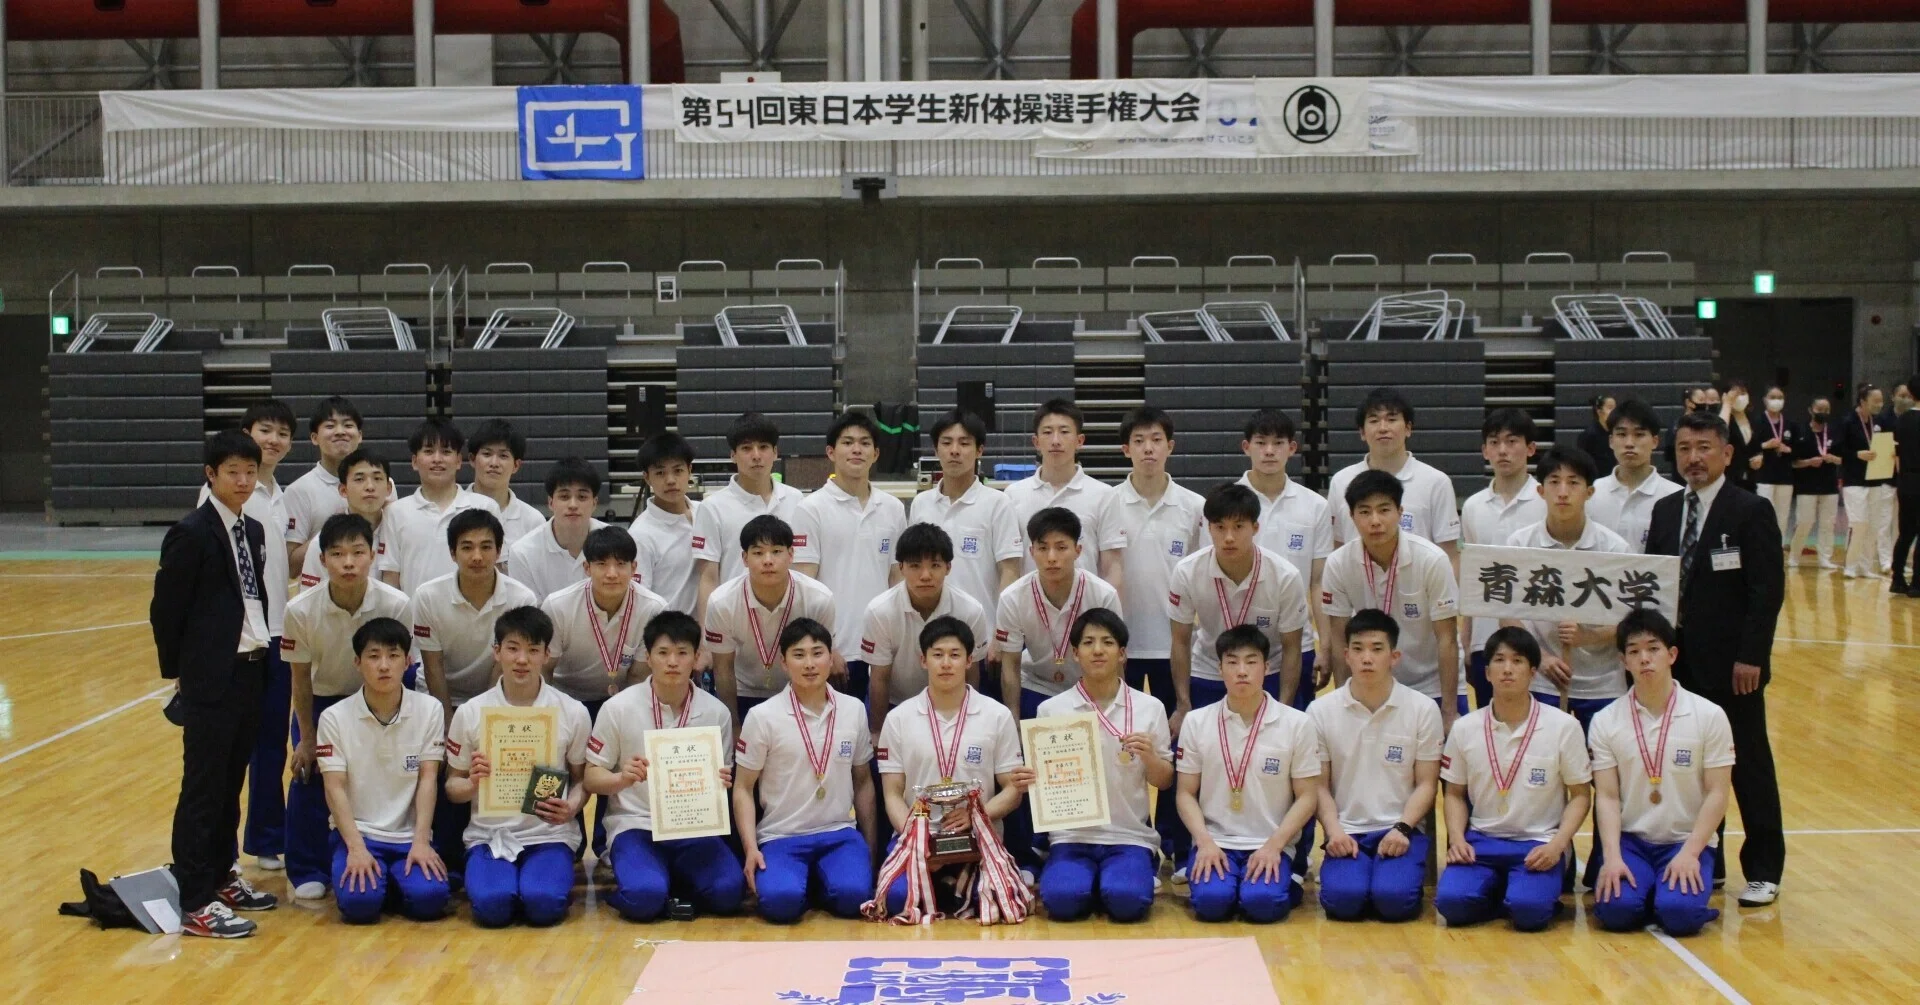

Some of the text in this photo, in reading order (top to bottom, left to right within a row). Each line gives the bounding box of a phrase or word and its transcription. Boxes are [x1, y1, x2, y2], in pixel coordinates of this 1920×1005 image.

[681, 91, 1200, 129] 第54回東日本学生新体操選手権大会
[1478, 561, 1661, 610] 青森大学
